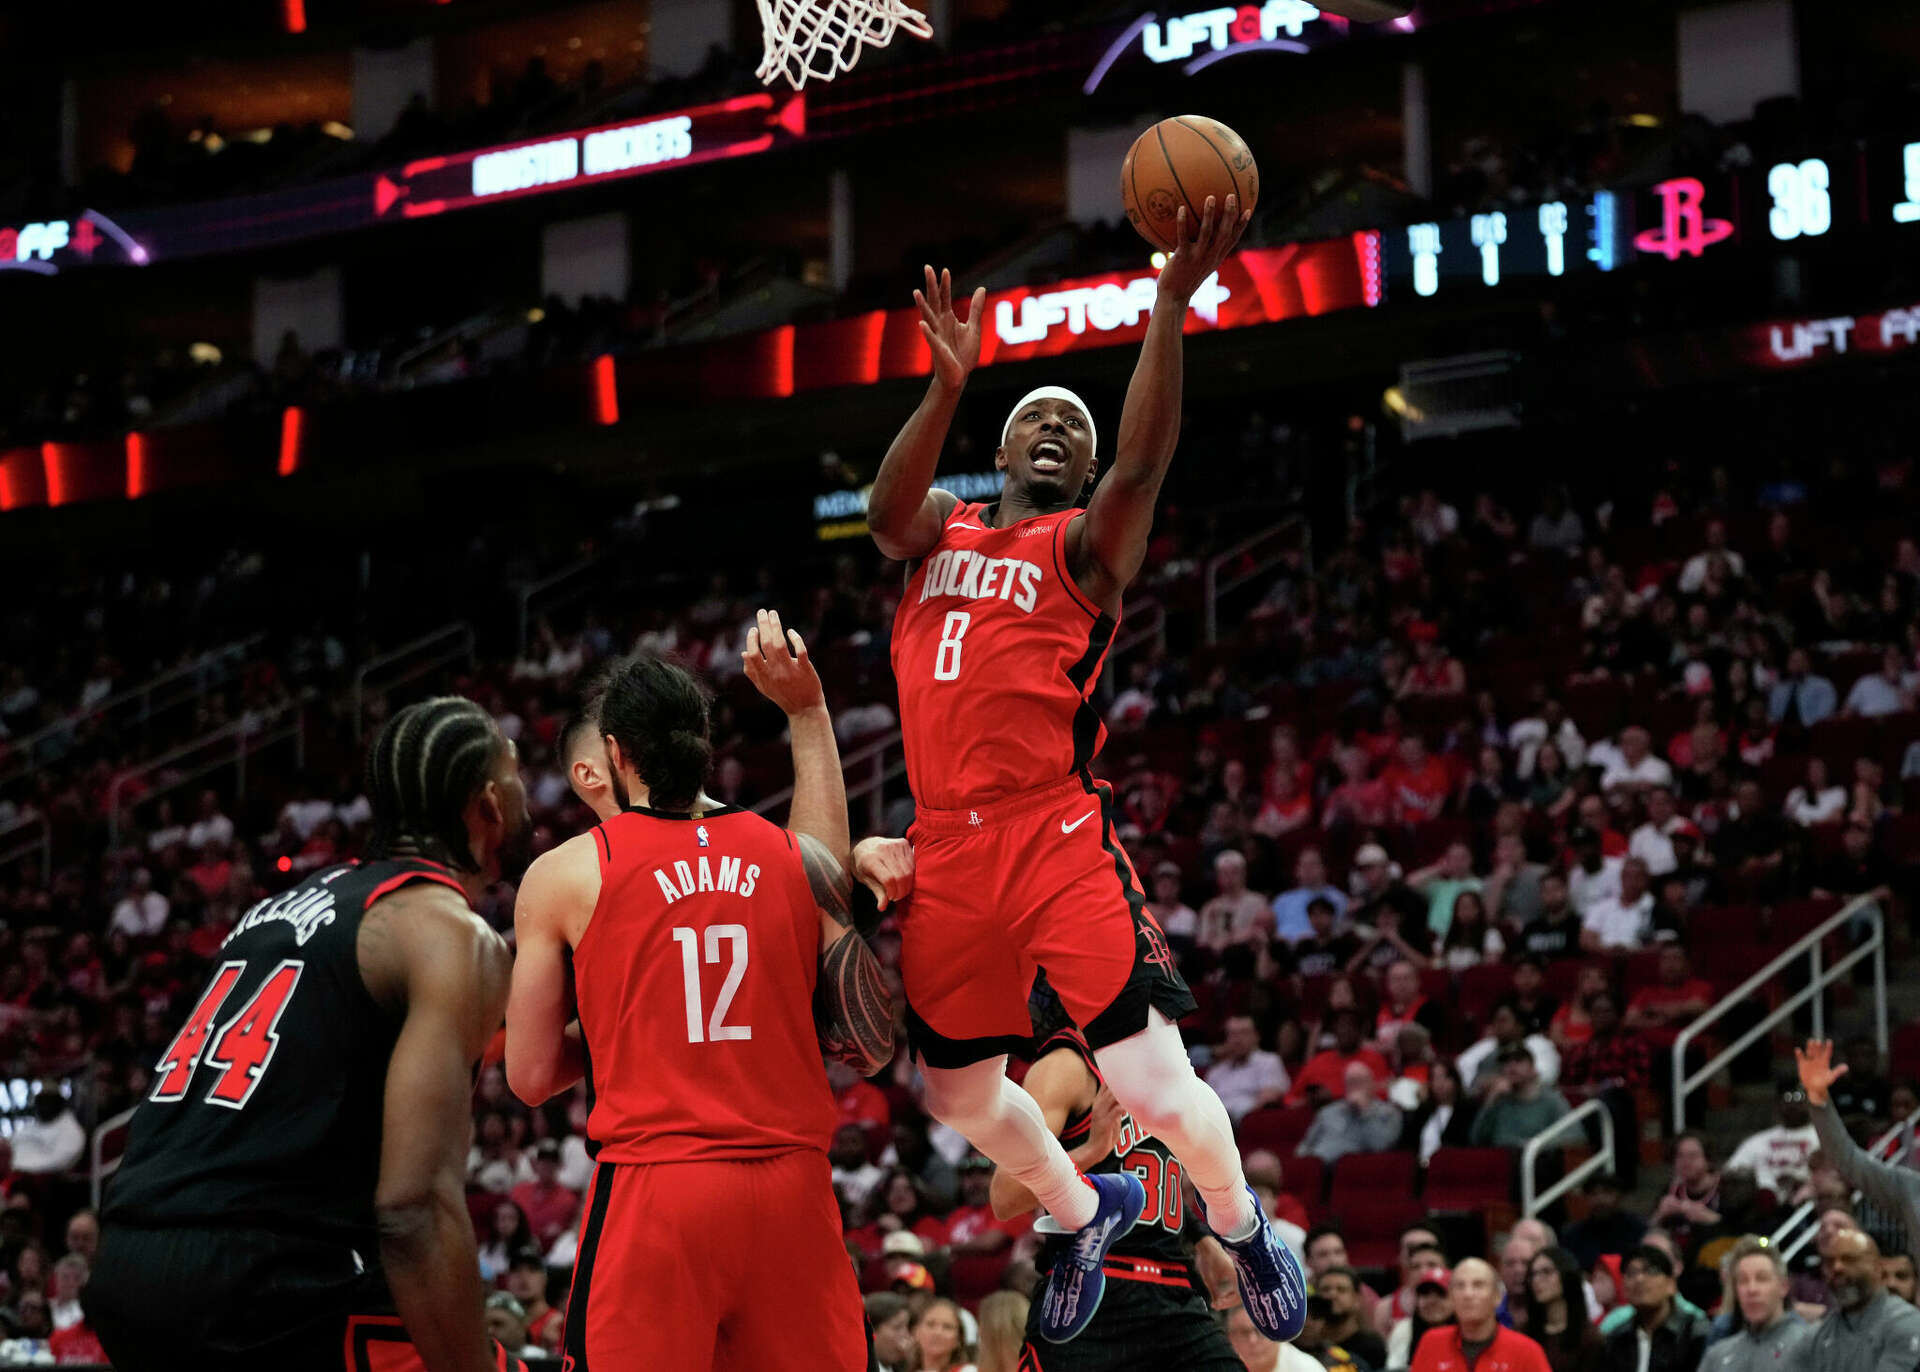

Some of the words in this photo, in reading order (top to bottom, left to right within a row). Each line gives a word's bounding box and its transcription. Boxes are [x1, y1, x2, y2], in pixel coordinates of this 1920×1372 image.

[996, 277, 1158, 345] LIFTOF
[918, 549, 1042, 613] ROCKETS
[934, 611, 971, 681] 8
[653, 855, 761, 904] ADAMS
[221, 887, 336, 946] ILLIAMS
[672, 924, 752, 1043] 12
[149, 959, 304, 1110] 44
[1120, 1148, 1184, 1235] 30
